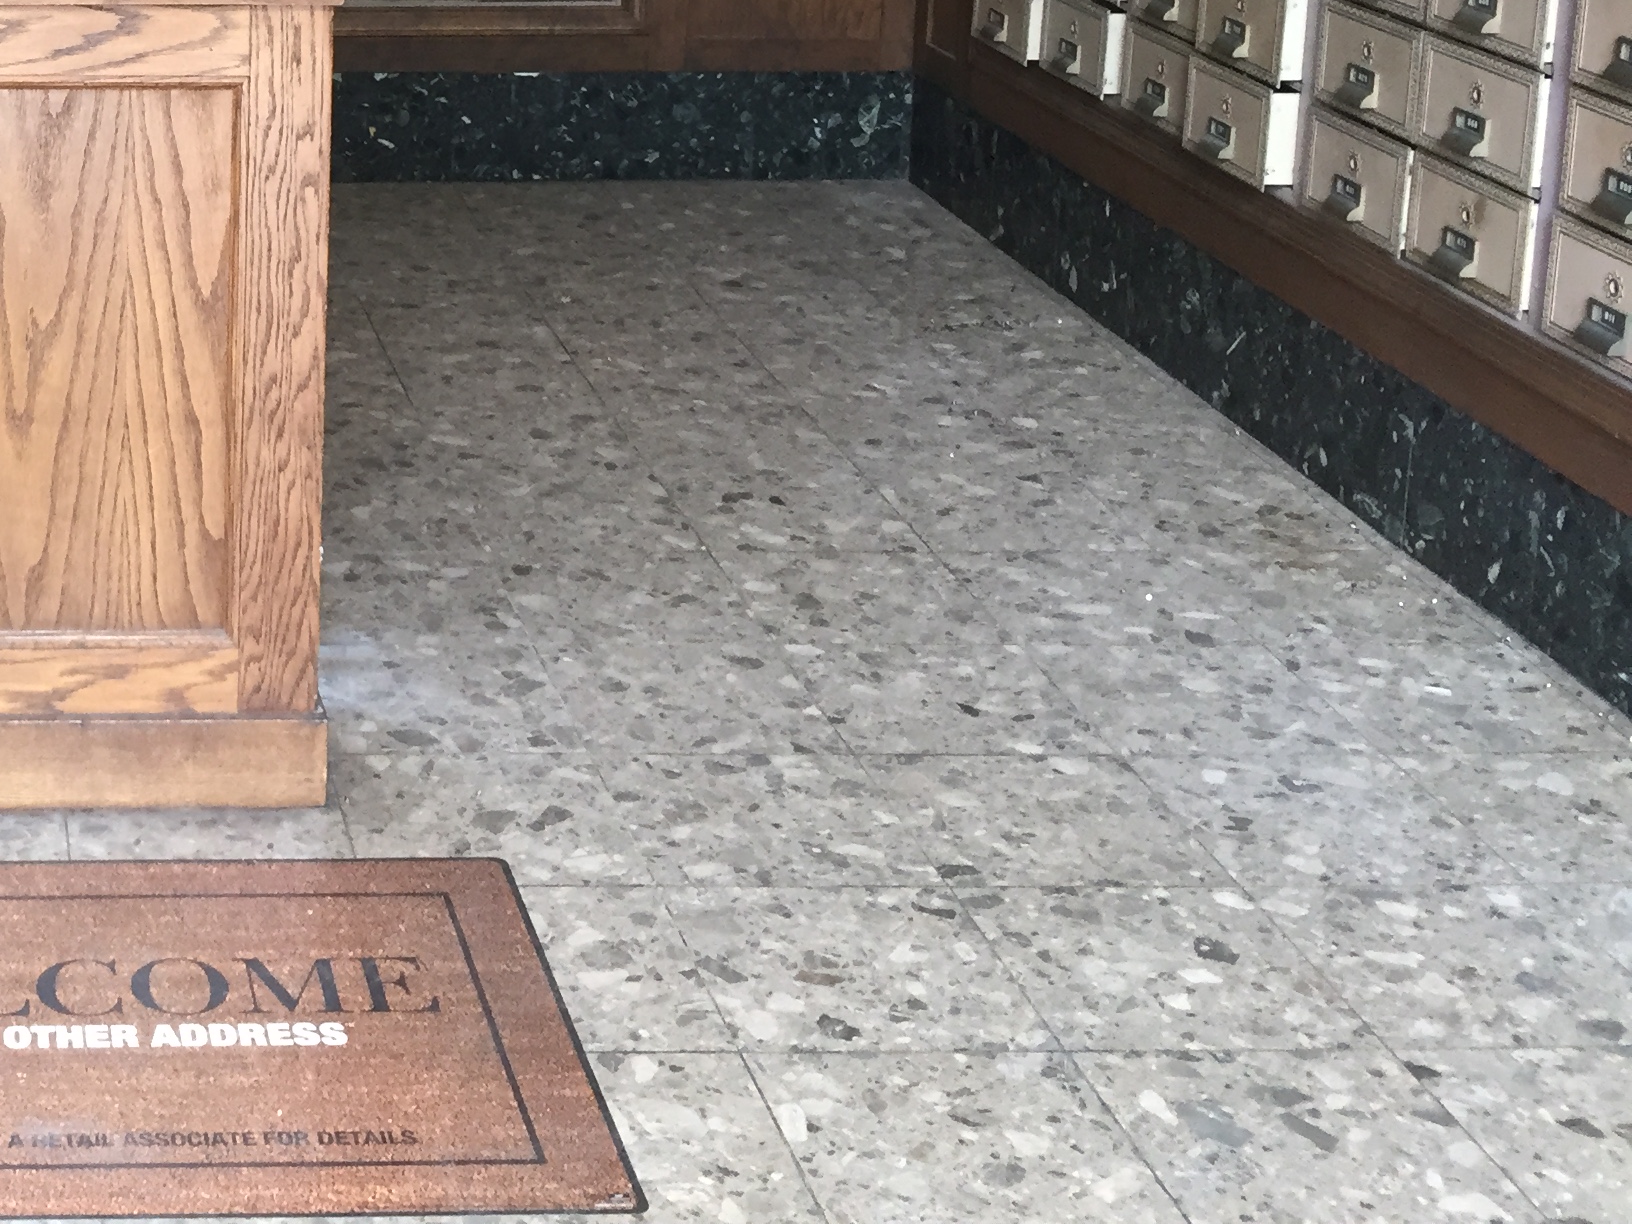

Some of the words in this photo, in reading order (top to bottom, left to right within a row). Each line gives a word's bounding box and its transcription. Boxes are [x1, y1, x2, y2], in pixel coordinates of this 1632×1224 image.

[2, 1023, 139, 1049] OTHER
[150, 1021, 349, 1048] ADDRESS
[7, 1133, 25, 1148] A
[31, 1132, 114, 1148] RETAIL
[122, 1131, 257, 1147] ASSOCIATE
[264, 1130, 310, 1146] FOR
